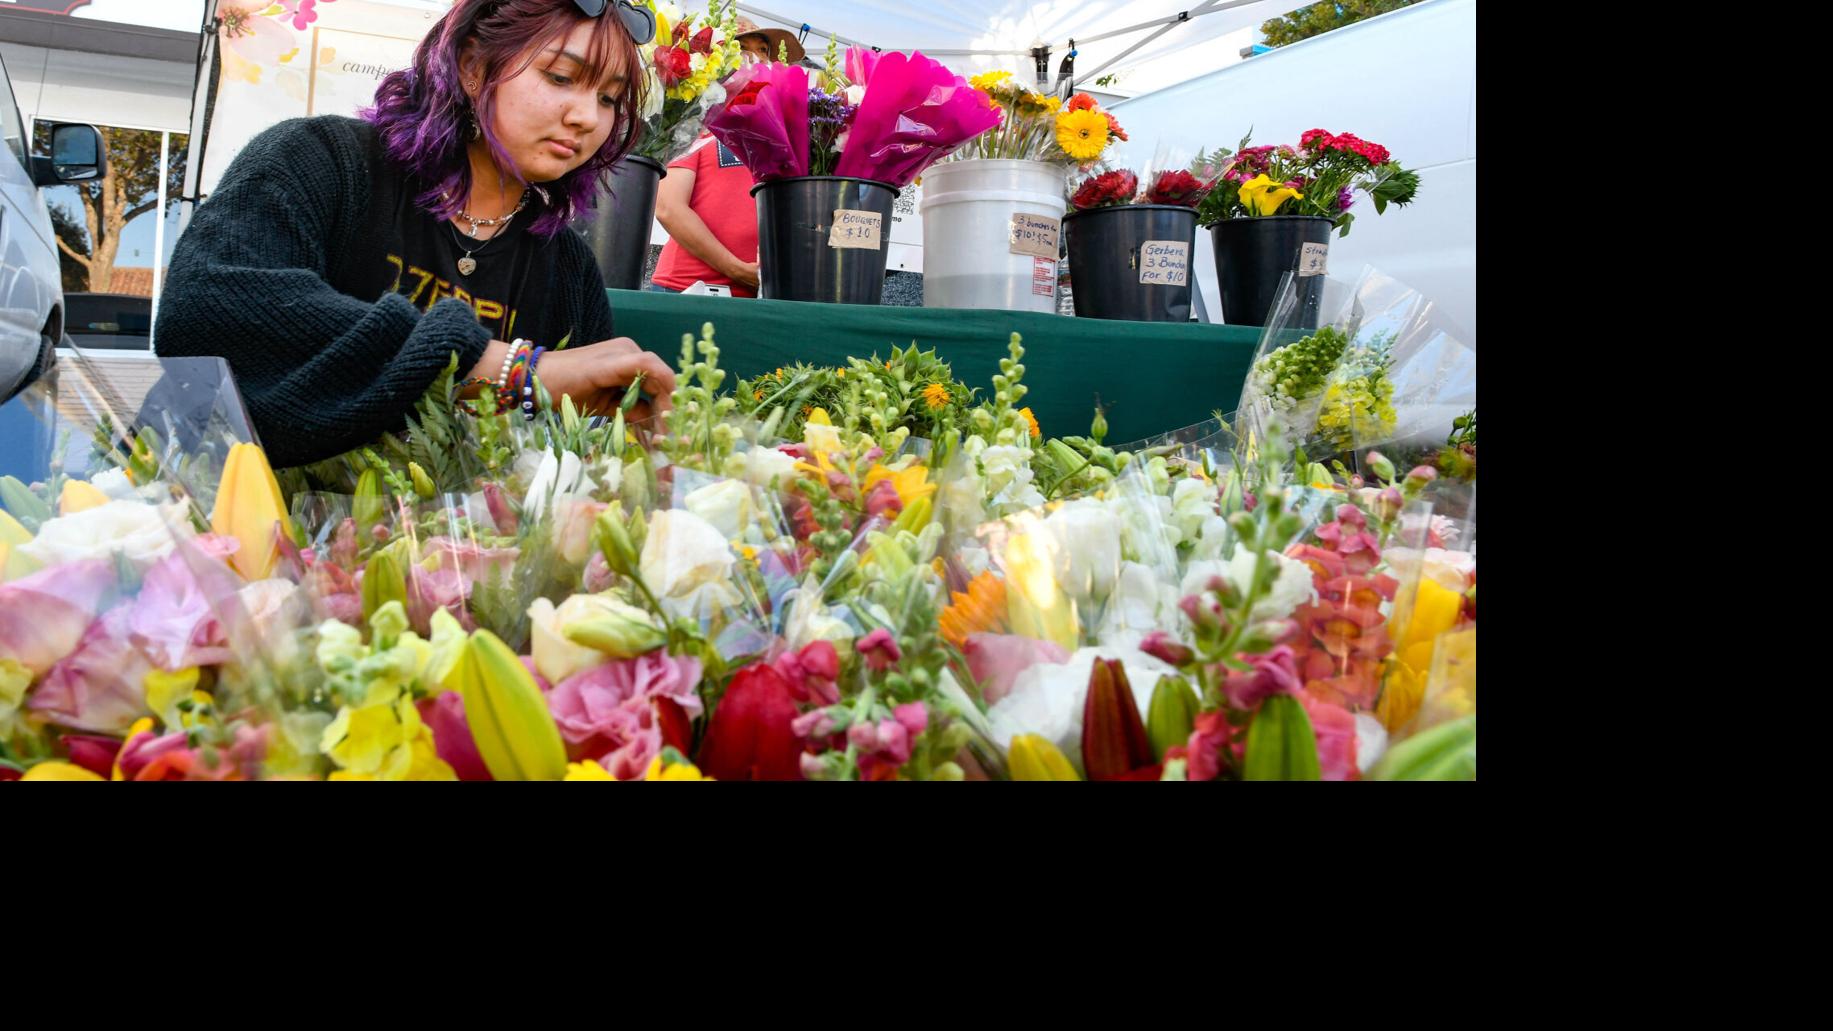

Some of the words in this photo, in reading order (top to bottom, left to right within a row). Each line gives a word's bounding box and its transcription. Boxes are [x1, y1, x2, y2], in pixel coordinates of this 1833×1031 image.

[1017, 215, 1025, 225] 3
[1145, 258, 1156, 268] 3
[1166, 270, 1185, 282] $10
